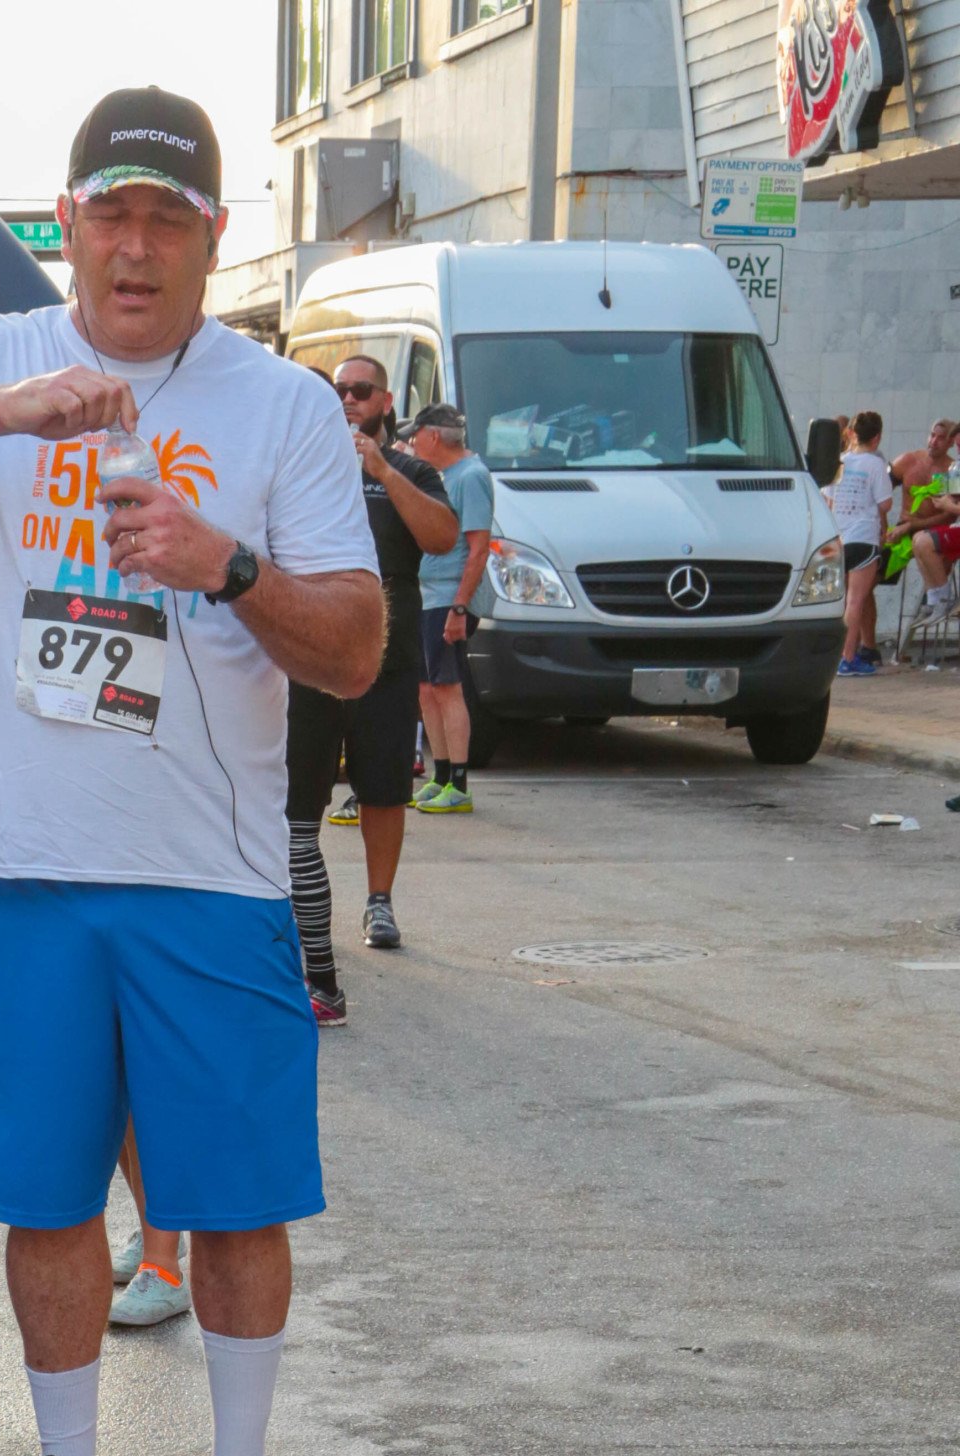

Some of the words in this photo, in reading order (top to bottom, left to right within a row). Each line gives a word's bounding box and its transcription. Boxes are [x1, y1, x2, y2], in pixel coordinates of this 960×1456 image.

[709, 160, 757, 170] PAYMENT
[758, 161, 803, 172] OPTIONS
[727, 256, 770, 277] PAY
[22, 513, 61, 550] ON
[91, 607, 116, 619] ROAD
[38, 626, 133, 682] 879
